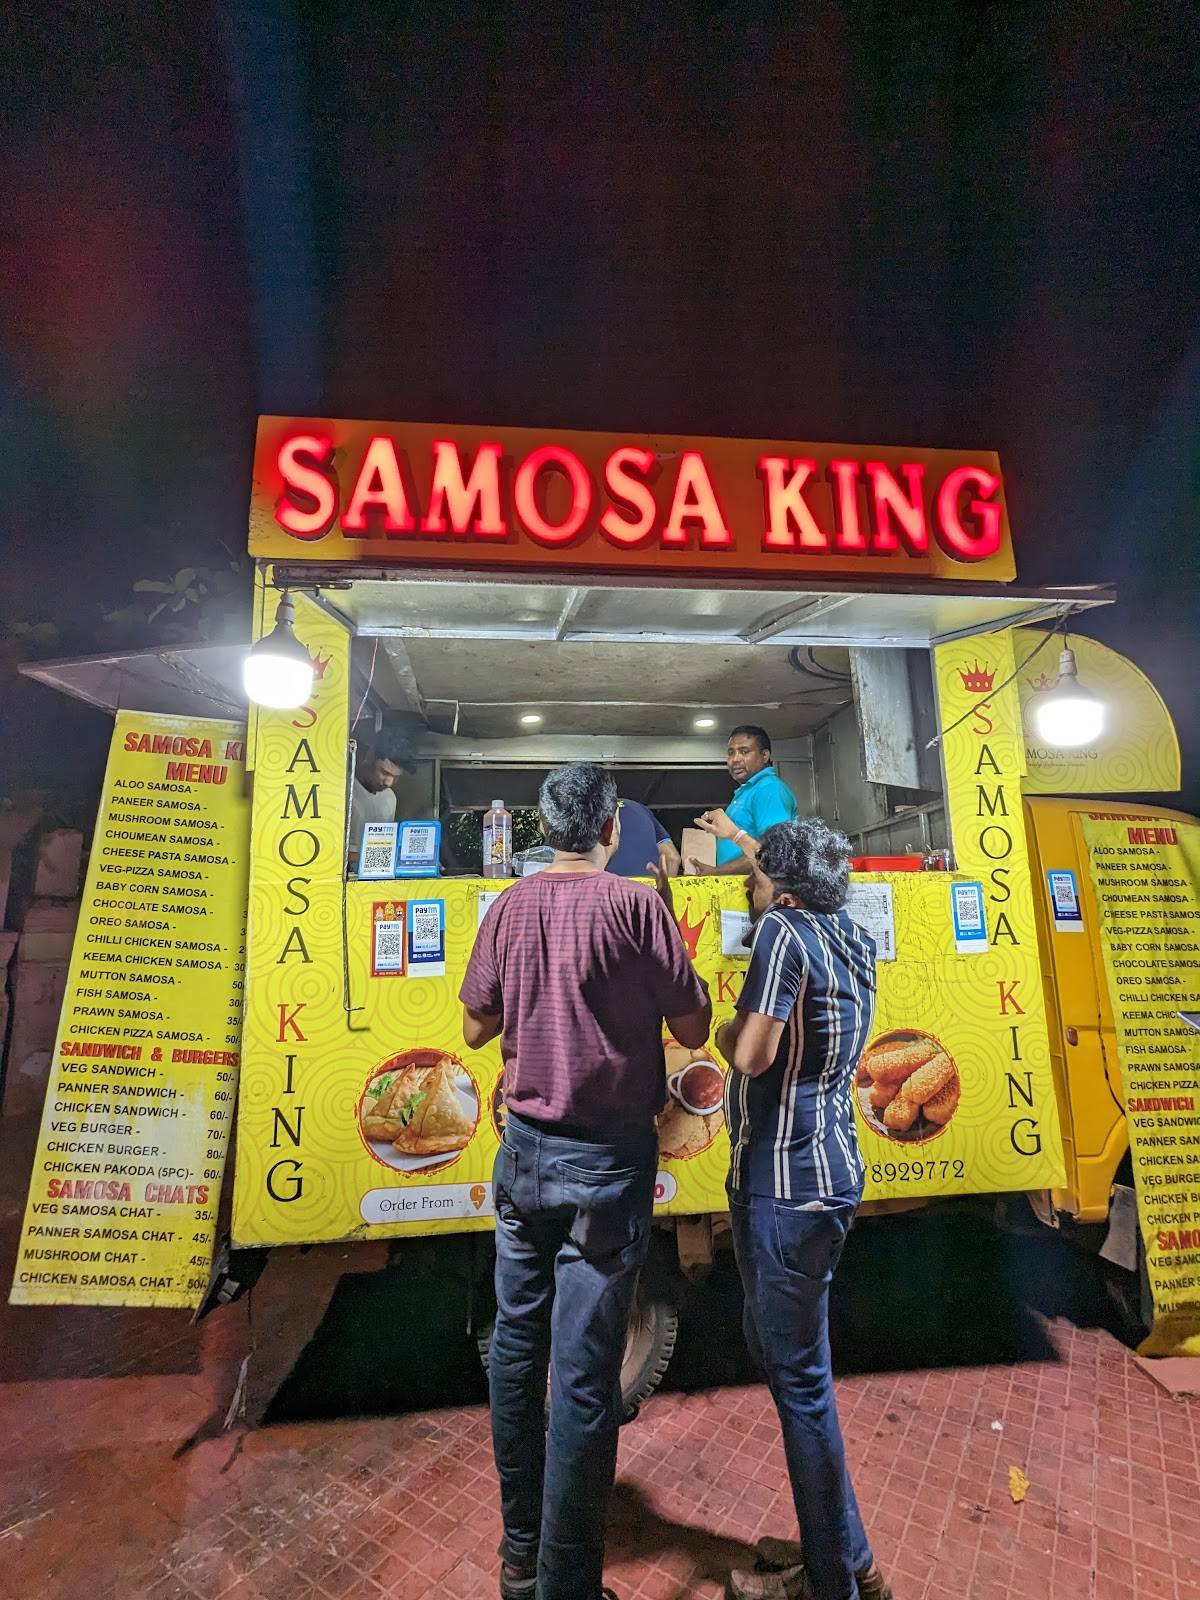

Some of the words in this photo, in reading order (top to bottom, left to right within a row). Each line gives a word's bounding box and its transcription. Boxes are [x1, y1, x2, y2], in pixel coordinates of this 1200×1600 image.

[275, 436, 732, 548] SAMOSA
[758, 456, 1001, 558] KING
[124, 732, 213, 758] SAMOSA
[166, 762, 228, 784] MENU
[114, 780, 144, 789] ALOO
[147, 782, 191, 793] SAMOSA
[112, 796, 153, 806] PANEER
[157, 800, 200, 811] SAMOSA
[109, 813, 170, 825] MUSHROOM
[174, 819, 218, 829] SAMOSA
[972, 702, 1020, 946] SAMOSA
[106, 830, 166, 842] CHOUMEAN
[169, 836, 213, 846] SAMOSA
[1128, 827, 1178, 845] MENU
[103, 848, 145, 858] CHEESE
[148, 851, 181, 861] PASTA
[184, 854, 228, 864] SAMOSA
[100, 864, 154, 876] VEG-PIZZA
[158, 869, 201, 879] SAMOSA
[96, 882, 126, 891] BABY
[130, 884, 159, 893] CORN
[163, 887, 207, 897] SAMOSA
[93, 899, 159, 911] CHOCOLATE
[162, 905, 206, 915] SAMOSA
[90, 917, 121, 926] OREO
[125, 919, 169, 930] SAMOSA
[87, 935, 121, 944] CHILLI
[125, 937, 171, 948] CHICKEN
[175, 941, 220, 952] SAMOSA
[84, 952, 122, 962] KEEMA
[126, 955, 172, 966] CHICKEN
[176, 959, 221, 969] SAMOSA
[1113, 960, 1167, 968] CHOCOLATE
[80, 970, 126, 981] MUTTON
[129, 974, 174, 984] SAMOSA
[77, 988, 101, 997] FISH
[106, 990, 150, 1001] SAMOSA
[73, 1007, 114, 1016] PRAWN
[118, 1010, 163, 1020] SAMOSA
[1122, 1011, 1154, 1019] KEEMA
[70, 1025, 120, 1035] CHICKEN
[123, 1028, 153, 1038] PIZZA
[157, 1031, 203, 1041] SAMOSA
[59, 1041, 142, 1061] SANDWICH
[151, 1047, 164, 1062] &
[171, 1048, 240, 1067] BURGERS
[1126, 1046, 1146, 1054] FISH
[1149, 1045, 1186, 1053] SAMOSA
[62, 1063, 87, 1073] VEG
[92, 1065, 155, 1077] SANDWICH
[996, 980, 1042, 1157] KING
[58, 1083, 109, 1093] PANNER
[113, 1086, 176, 1098] SANDWICH
[1131, 1081, 1170, 1090] CHICKEN
[55, 1102, 110, 1113] CHICKEN
[114, 1105, 178, 1117] SANDWICH
[266, 1003, 309, 1203] KING
[1128, 1097, 1195, 1112] SANDWICH
[52, 1122, 76, 1131] VEG
[80, 1123, 132, 1135] BURGER
[1134, 1119, 1154, 1127] VEG
[1137, 1137, 1177, 1146] PANNER
[1180, 1136, 1200, 1145] SAN
[48, 1142, 104, 1152] CHICKEN
[108, 1144, 159, 1156] BURGER
[44, 1162, 100, 1173] CHICKEN
[104, 1164, 154, 1175] PAKODA
[1139, 1156, 1183, 1166] CHICKEN
[1142, 1176, 1162, 1186] VEG
[48, 1179, 131, 1201] SAMOSA
[144, 1184, 209, 1205] CHATS
[1144, 1193, 1188, 1204] CHICKEN
[33, 1204, 58, 1213] VEG
[62, 1205, 116, 1216] SAMOSA
[120, 1208, 154, 1217] CHAT
[380, 1199, 418, 1213] Order
[422, 1196, 454, 1209] From
[1147, 1213, 1191, 1225] CHICKEN
[28, 1226, 80, 1238] PANNER
[84, 1229, 137, 1240] SAMOSA
[142, 1231, 175, 1241] CHAT
[24, 1249, 100, 1261] MUSHROOM
[105, 1252, 138, 1263] CHAT
[1150, 1257, 1172, 1267] VEG
[20, 1273, 77, 1284] CHICKEN
[81, 1275, 135, 1286] SAMOSA
[140, 1277, 173, 1287] CHAT
